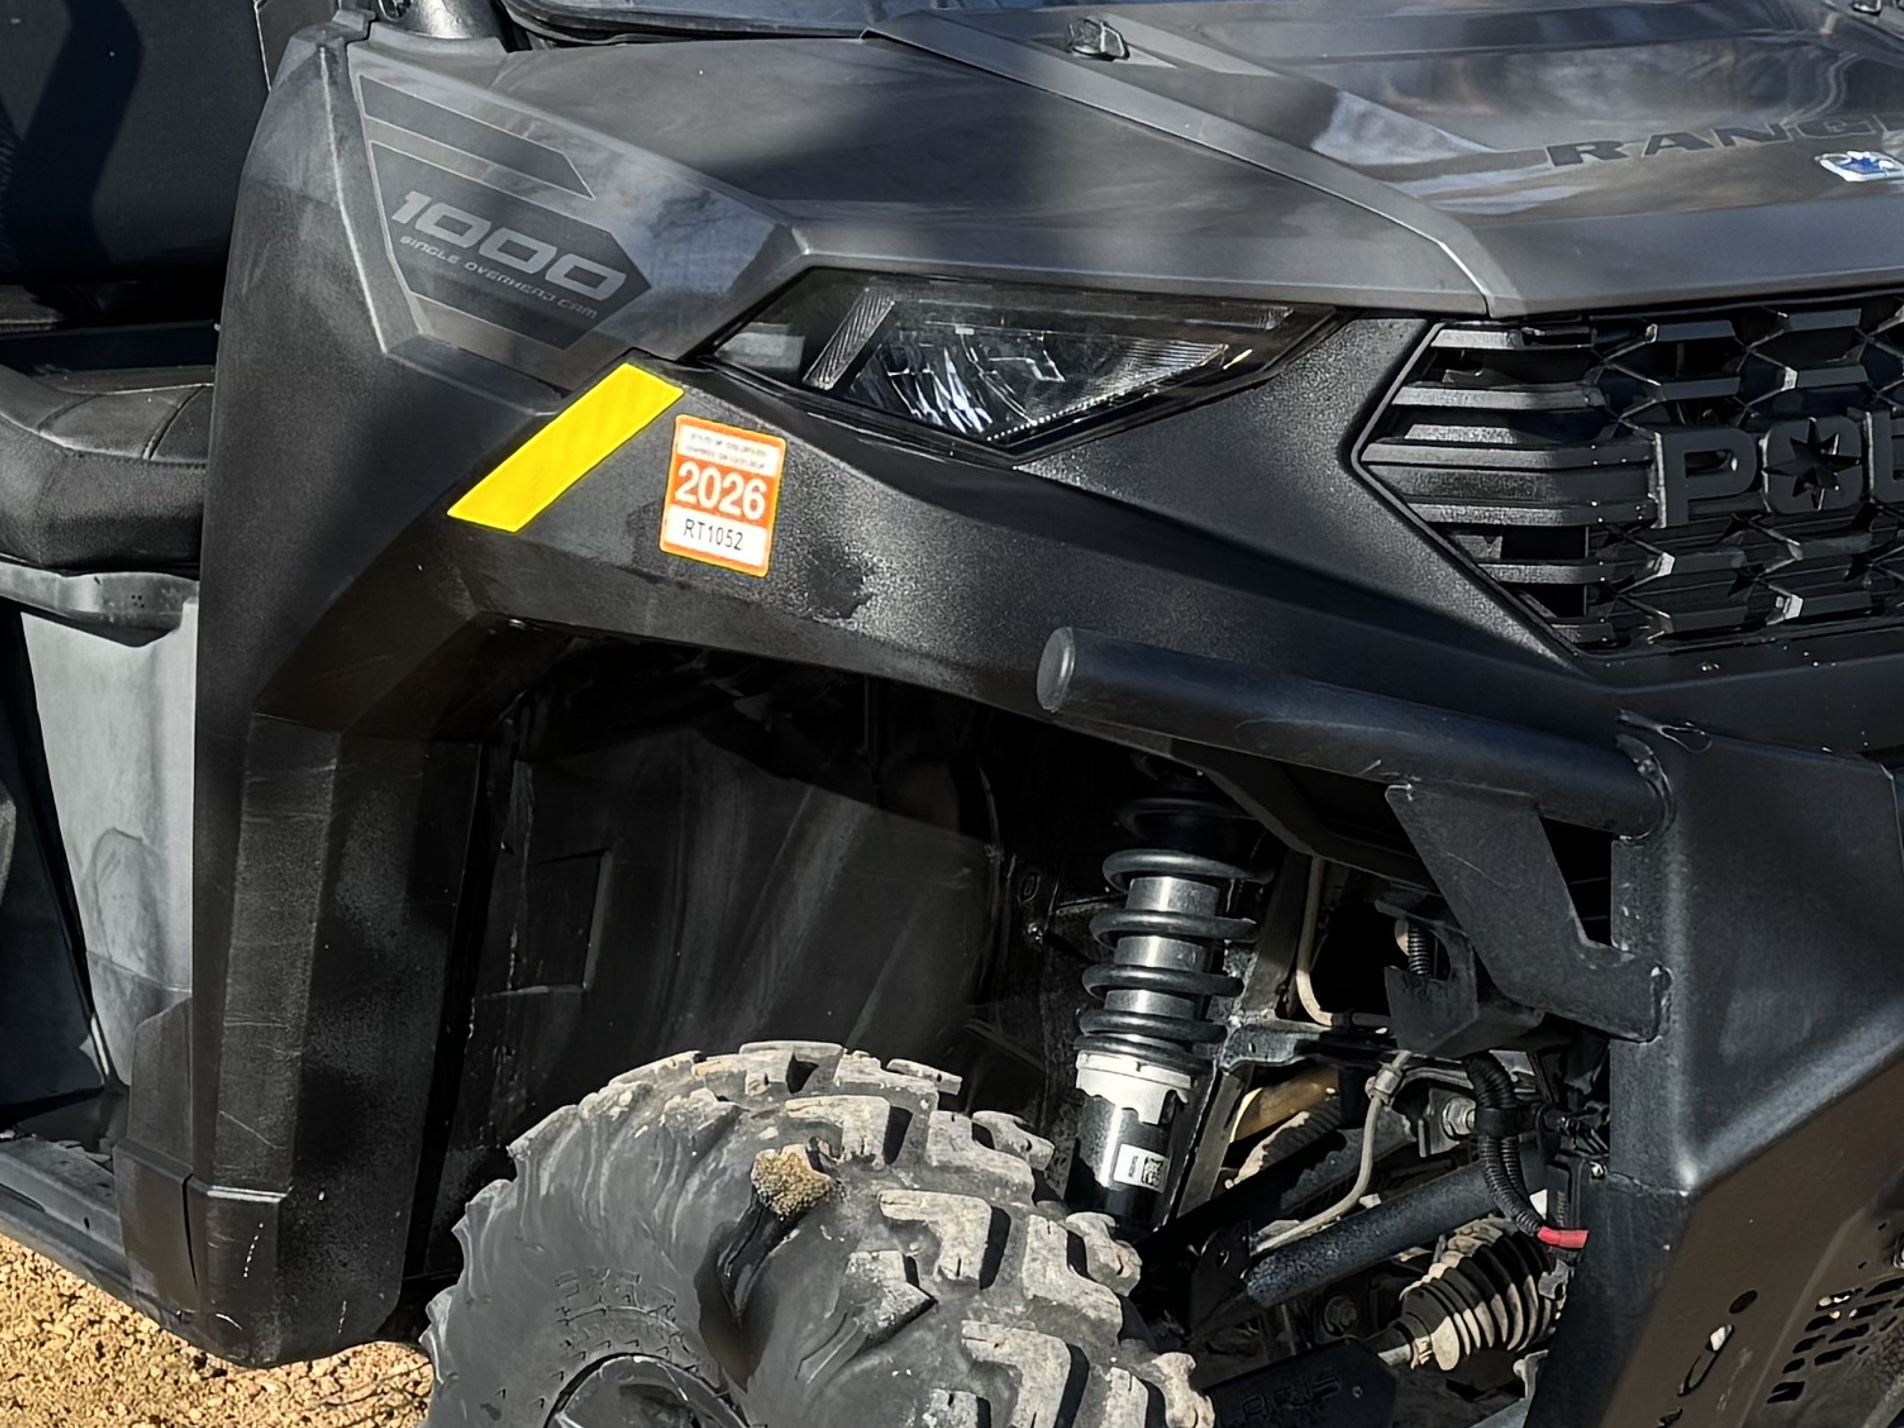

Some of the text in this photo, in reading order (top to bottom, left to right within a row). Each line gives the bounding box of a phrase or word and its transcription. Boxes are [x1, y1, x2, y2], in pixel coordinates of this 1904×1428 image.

[391, 190, 627, 301] 1000
[399, 234, 599, 319] SINGLE OVERHEAD CAM
[674, 460, 768, 521] 2026
[683, 517, 744, 551] RT1052
